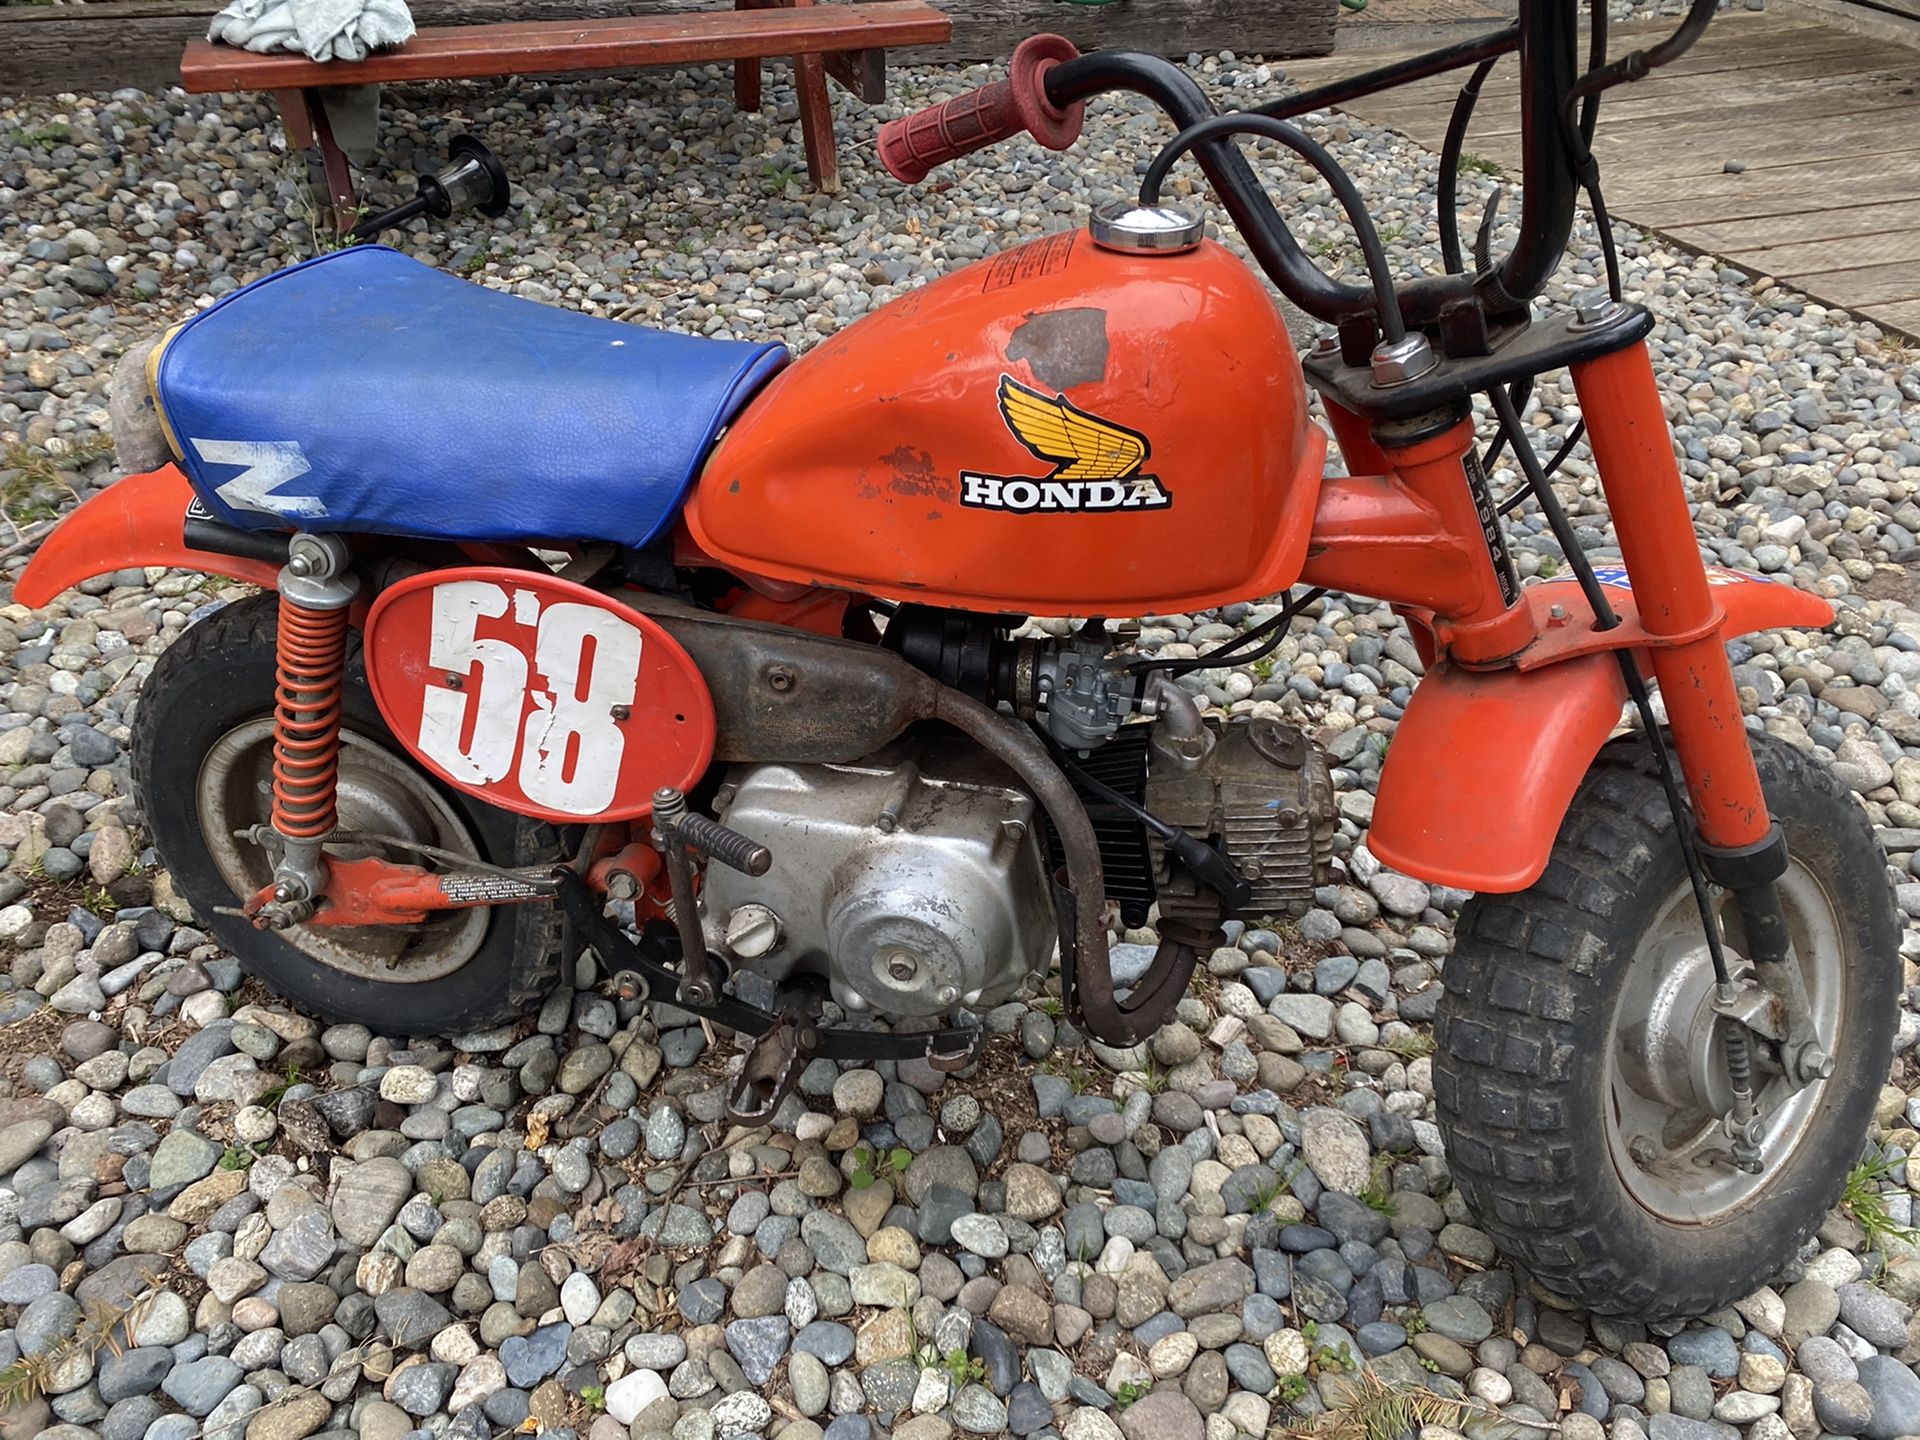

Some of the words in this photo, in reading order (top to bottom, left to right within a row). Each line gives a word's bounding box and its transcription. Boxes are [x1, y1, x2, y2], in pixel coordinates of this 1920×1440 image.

[189, 437, 330, 519] Z
[964, 476, 1168, 508] HONDA
[1476, 490, 1502, 562] 1984
[1499, 571, 1511, 599] MODEL
[417, 580, 643, 815] 58
